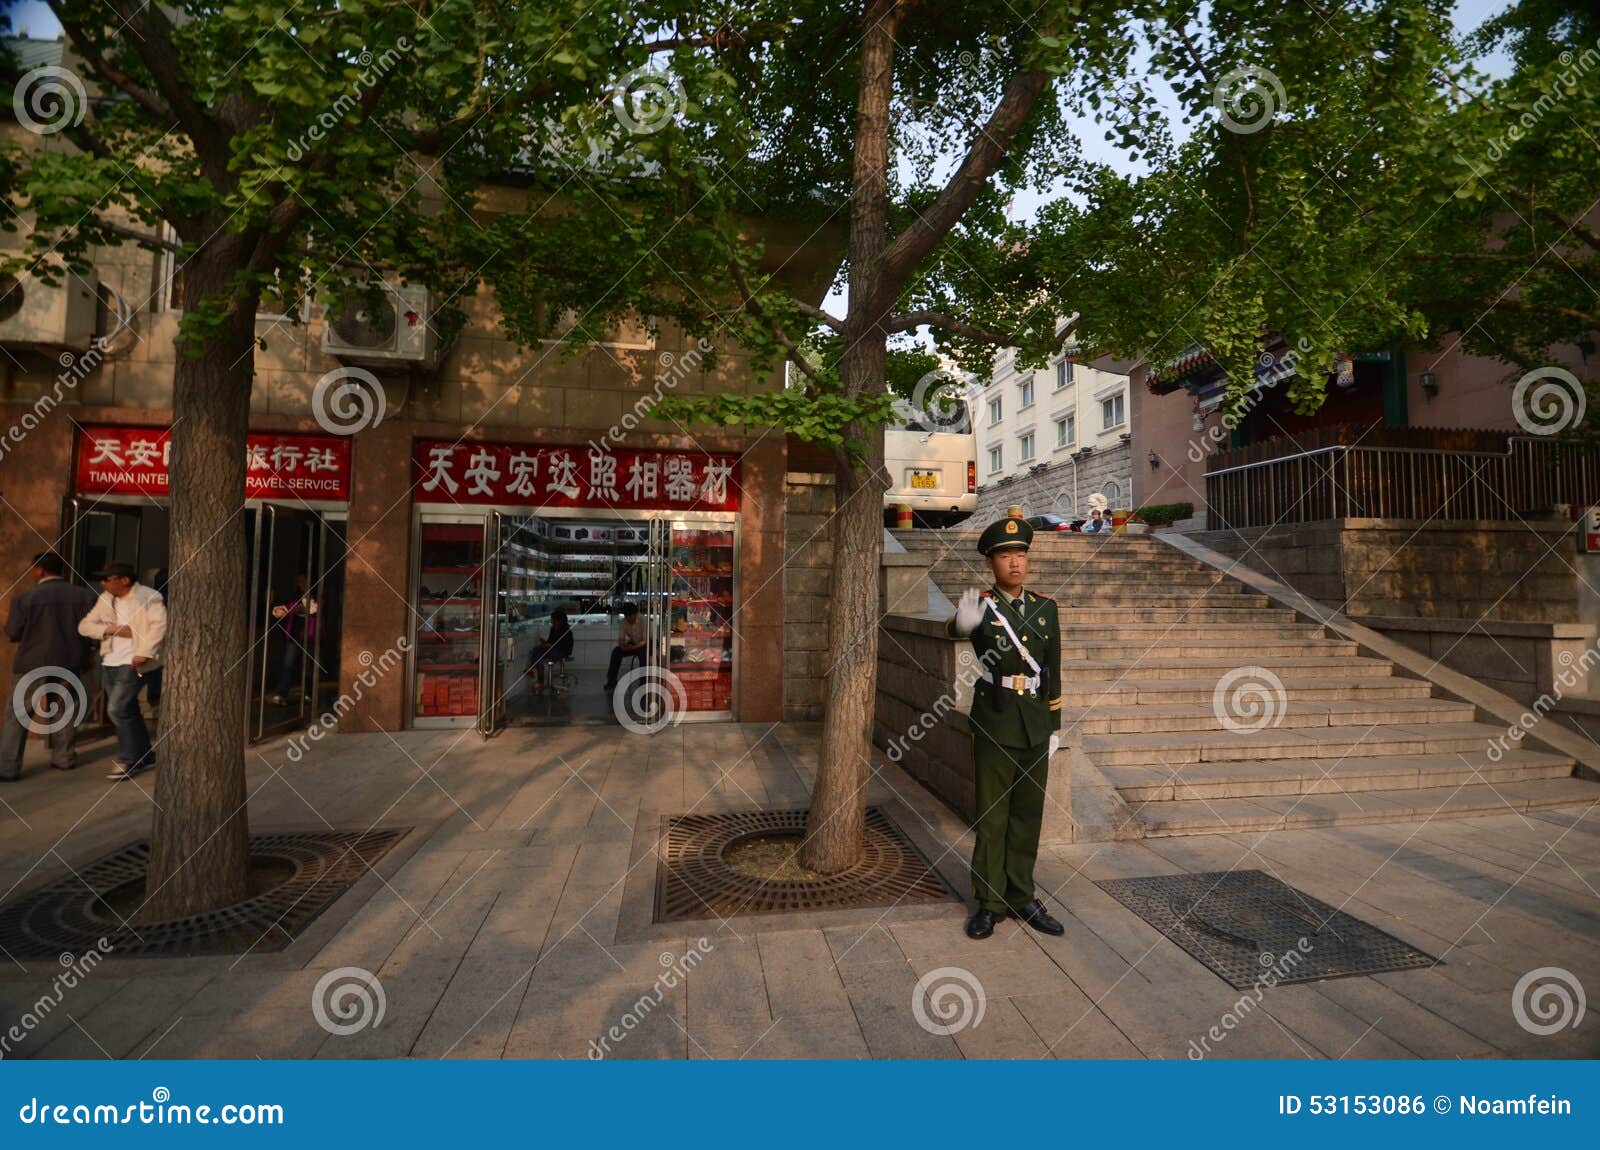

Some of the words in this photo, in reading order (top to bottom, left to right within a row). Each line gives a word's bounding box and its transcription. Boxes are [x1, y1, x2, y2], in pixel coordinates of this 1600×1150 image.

[89, 439, 171, 468] 天安
[89, 471, 135, 484] TIANAN
[137, 473, 168, 485] INTE
[246, 476, 285, 489] RAVEL
[288, 478, 340, 491] SERVICE
[423, 447, 733, 505] 天安宏达照相器材
